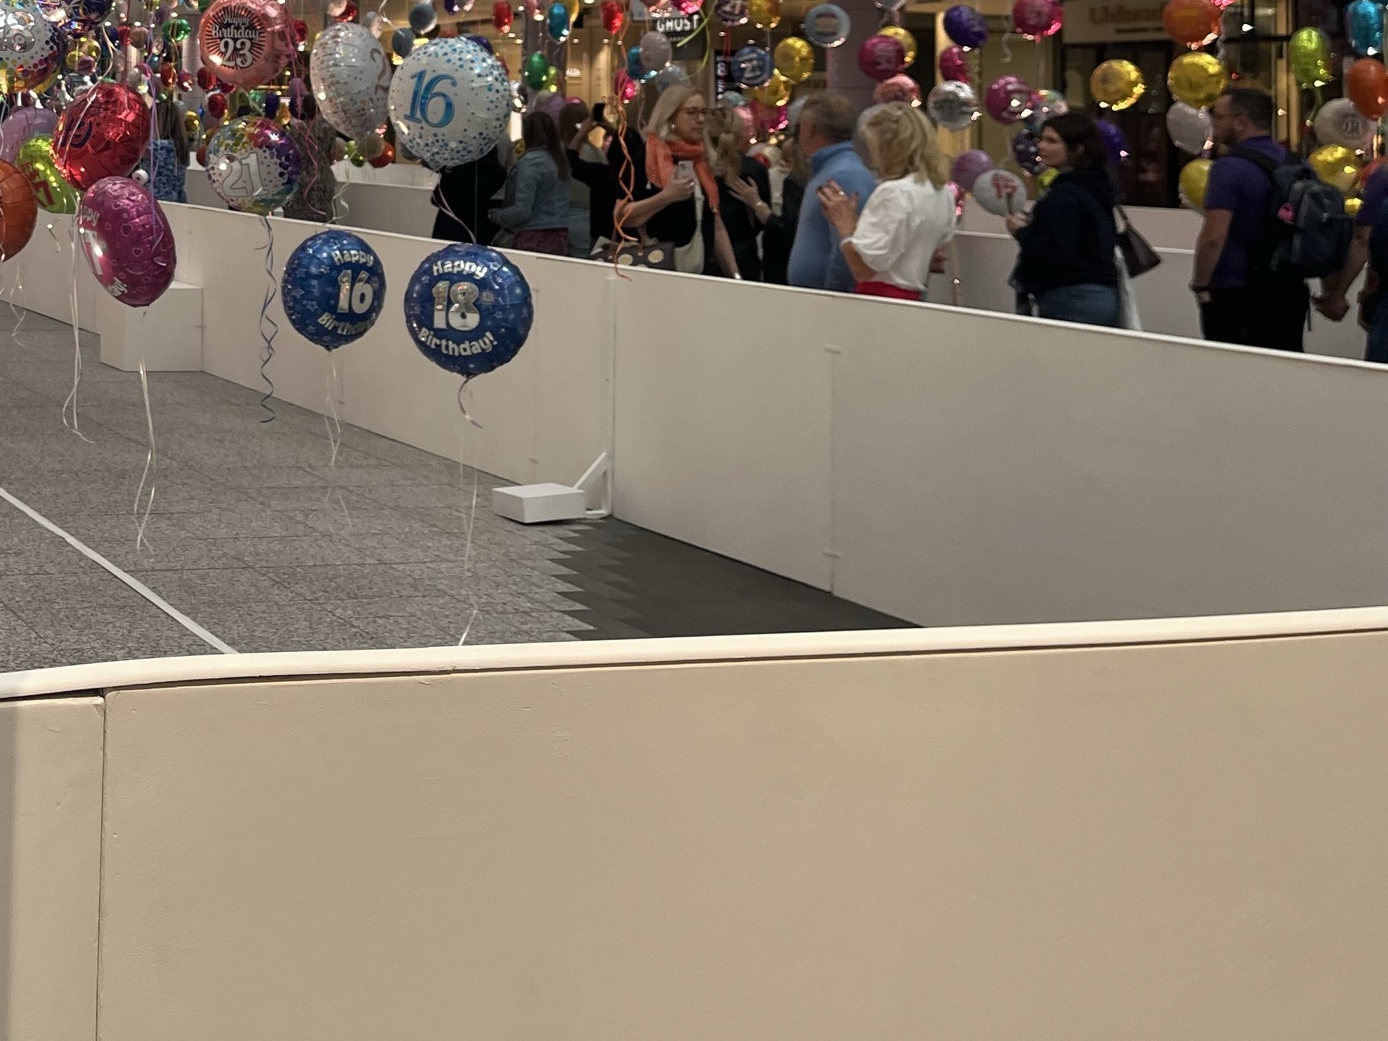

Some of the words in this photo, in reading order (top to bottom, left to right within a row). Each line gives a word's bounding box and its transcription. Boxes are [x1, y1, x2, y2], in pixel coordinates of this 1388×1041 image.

[212, 25, 261, 41] Birthday
[223, 15, 250, 27] Happy
[219, 38, 253, 68] 23
[404, 69, 458, 128] 16
[222, 151, 269, 198] 21
[331, 249, 375, 269] Happy
[432, 260, 488, 280] Happy
[337, 269, 374, 314] 16
[431, 280, 480, 331] 18
[419, 327, 498, 357] Birthday!
